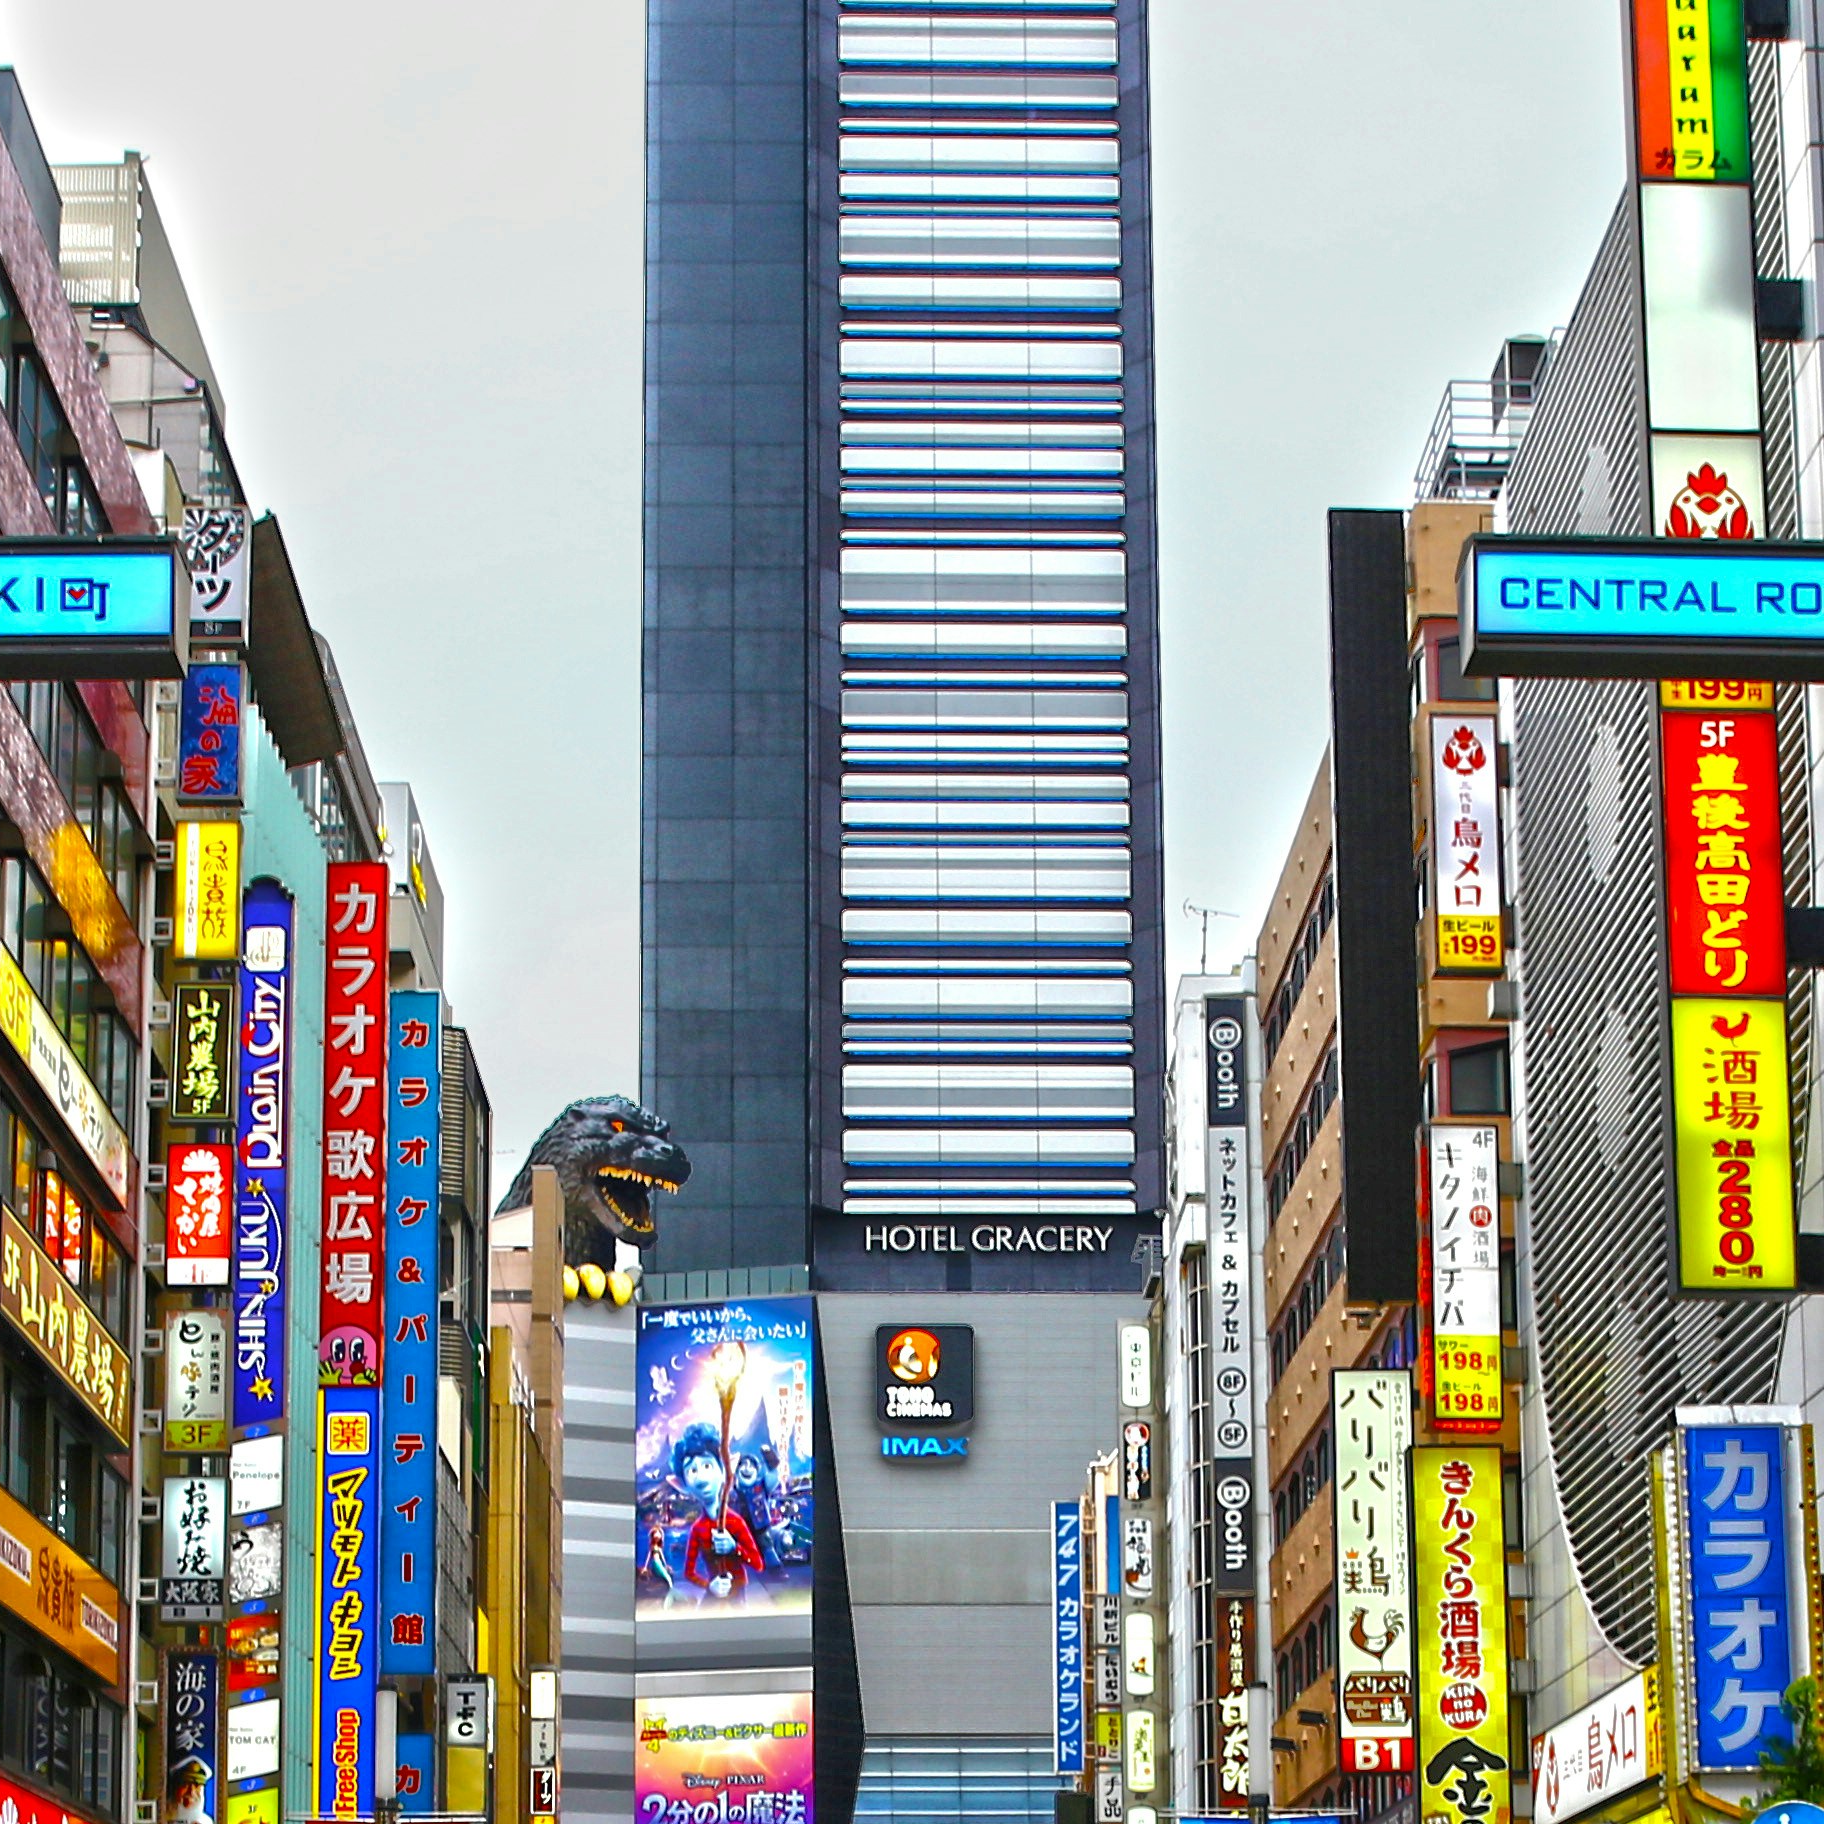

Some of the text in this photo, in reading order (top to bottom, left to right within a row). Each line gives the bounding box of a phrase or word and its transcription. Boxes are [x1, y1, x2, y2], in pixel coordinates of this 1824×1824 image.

[1655, 149, 1733, 171] ガラム
[1500, 577, 1737, 614] CENTRAL
[181, 686, 239, 796] 海の家
[1701, 721, 1734, 748] 5F
[201, 840, 229, 940] 鳥貴族
[1451, 818, 1483, 907] 鳥メロ
[1691, 752, 1750, 989] 豊後高田どり
[1443, 918, 1496, 934] 生ビール
[1449, 934, 1497, 957] 199
[4, 970, 26, 1040] 3F
[182, 988, 222, 1100] 山内農場
[326, 882, 378, 1306] カラオケ歌広場
[1209, 1015, 1244, 1110] Booth
[1704, 1048, 1764, 1131] 酒場
[192, 1099, 212, 1116] 5F
[1471, 1131, 1494, 1150] 4F
[1713, 1141, 1755, 1159] 全品
[866, 1227, 1115, 1253] HOTEL GRACERY
[1218, 1136, 1241, 1354] ネットカフェ カプセル
[1438, 1140, 1465, 1328] キタノイチバ
[1718, 1160, 1756, 1266] 280
[2, 1231, 24, 1297] 5F
[235, 1199, 283, 1372] SHINJUKU
[19, 1249, 116, 1422] 山内農場
[391, 1018, 430, 1646] カラオケ&パーティー館
[181, 1425, 213, 1446] 3F
[330, 1416, 369, 1452] 薬
[885, 1385, 936, 1403] TOHO
[885, 1401, 953, 1418] CINEMAS
[882, 1437, 968, 1456] IMAX
[1217, 1476, 1250, 1572] Booth
[327, 1465, 371, 1682] マツモトキヨシ
[1438, 1459, 1482, 1681] きんくら酒場
[1702, 1439, 1782, 1753] カラオケ
[1058, 1514, 1080, 1763] 747 カラオケランド
[174, 1660, 208, 1751] 海の家
[335, 1708, 359, 1761] Shop
[1587, 1703, 1638, 1792] 鳥メロ
[725, 1774, 766, 1786] PIXAR
[1354, 1740, 1403, 1771] B1
